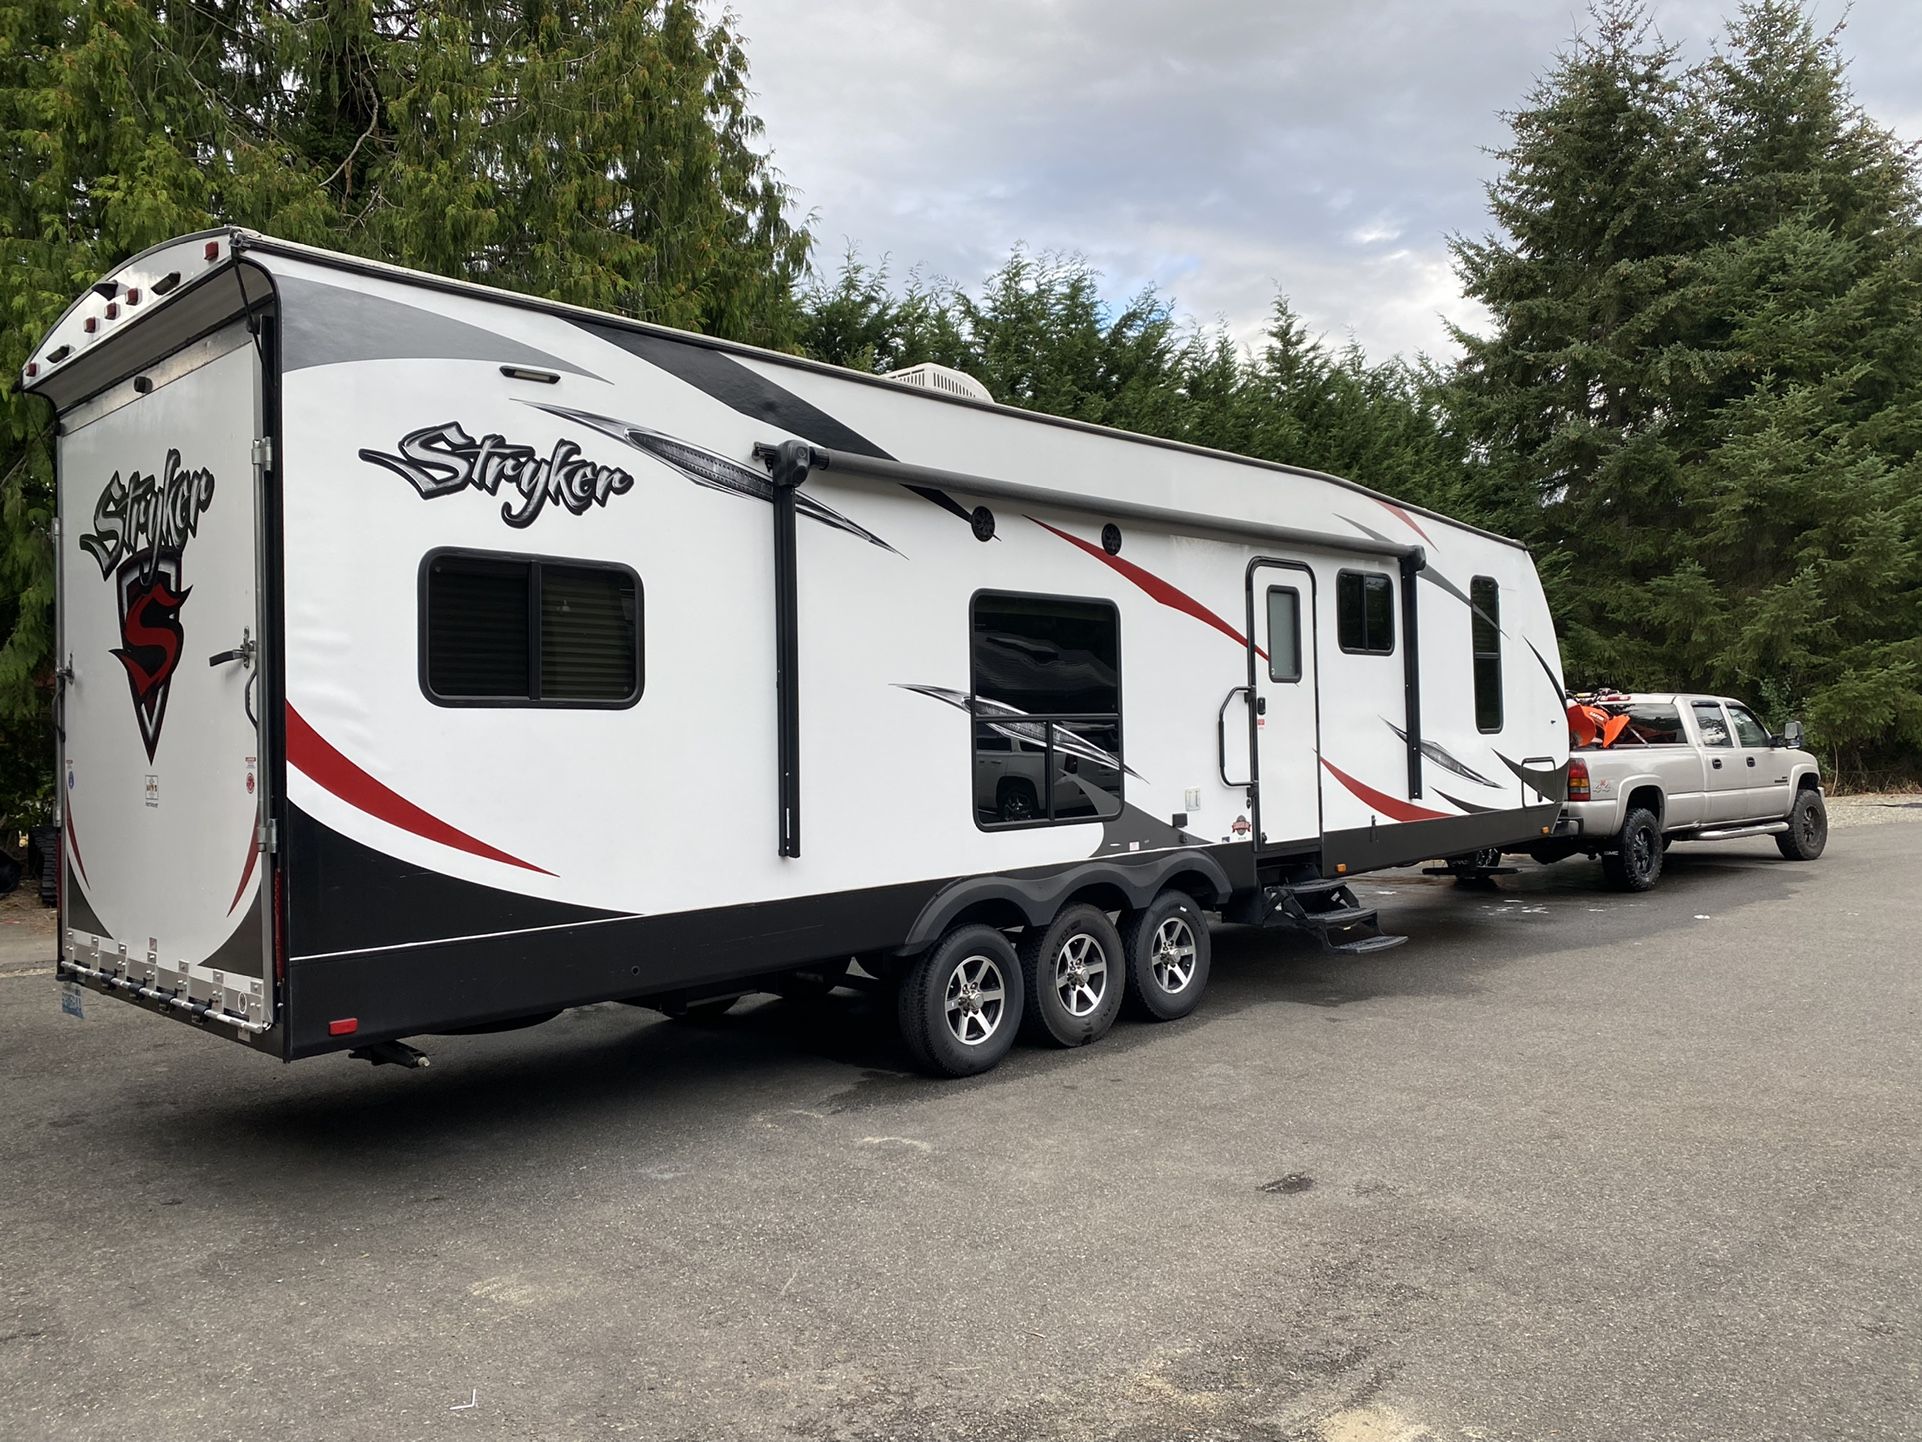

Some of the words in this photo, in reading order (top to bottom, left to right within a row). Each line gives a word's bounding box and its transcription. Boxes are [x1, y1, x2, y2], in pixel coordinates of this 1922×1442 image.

[80, 448, 214, 585] Stryker
[358, 421, 634, 529] Stryker
[109, 582, 190, 699] S
